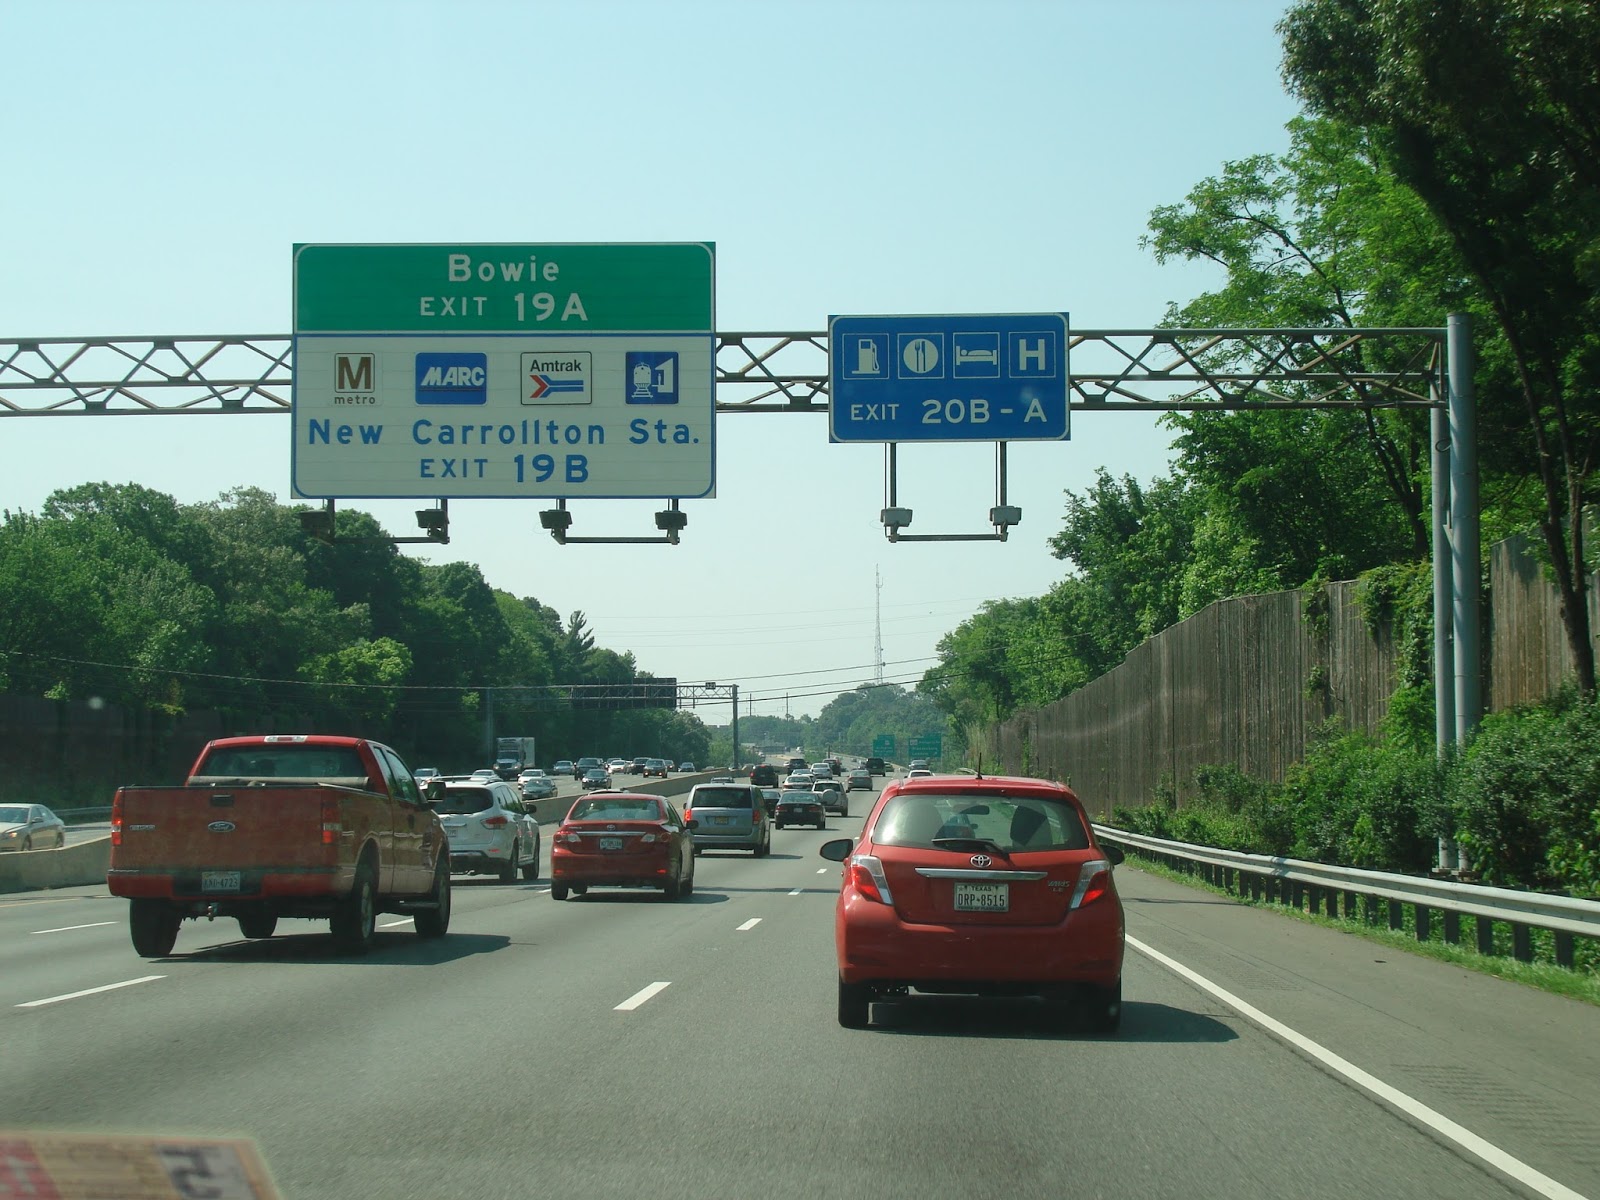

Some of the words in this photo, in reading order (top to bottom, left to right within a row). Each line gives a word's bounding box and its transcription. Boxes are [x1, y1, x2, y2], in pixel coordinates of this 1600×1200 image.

[448, 254, 560, 283] Bowie
[420, 296, 488, 317] EXIT
[514, 292, 589, 322] 19A
[529, 358, 583, 373] Amtrak
[1019, 338, 1046, 371] H
[337, 356, 372, 390] M
[420, 366, 485, 387] MARC
[334, 394, 376, 405] metro
[850, 403, 900, 421] EXIT
[921, 399, 990, 424] 20B
[1023, 398, 1047, 423] A
[308, 418, 384, 445] New
[412, 418, 605, 445] Carrollton
[628, 418, 700, 445] Sta.
[420, 458, 489, 478] EXIT
[514, 453, 589, 483] 19B
